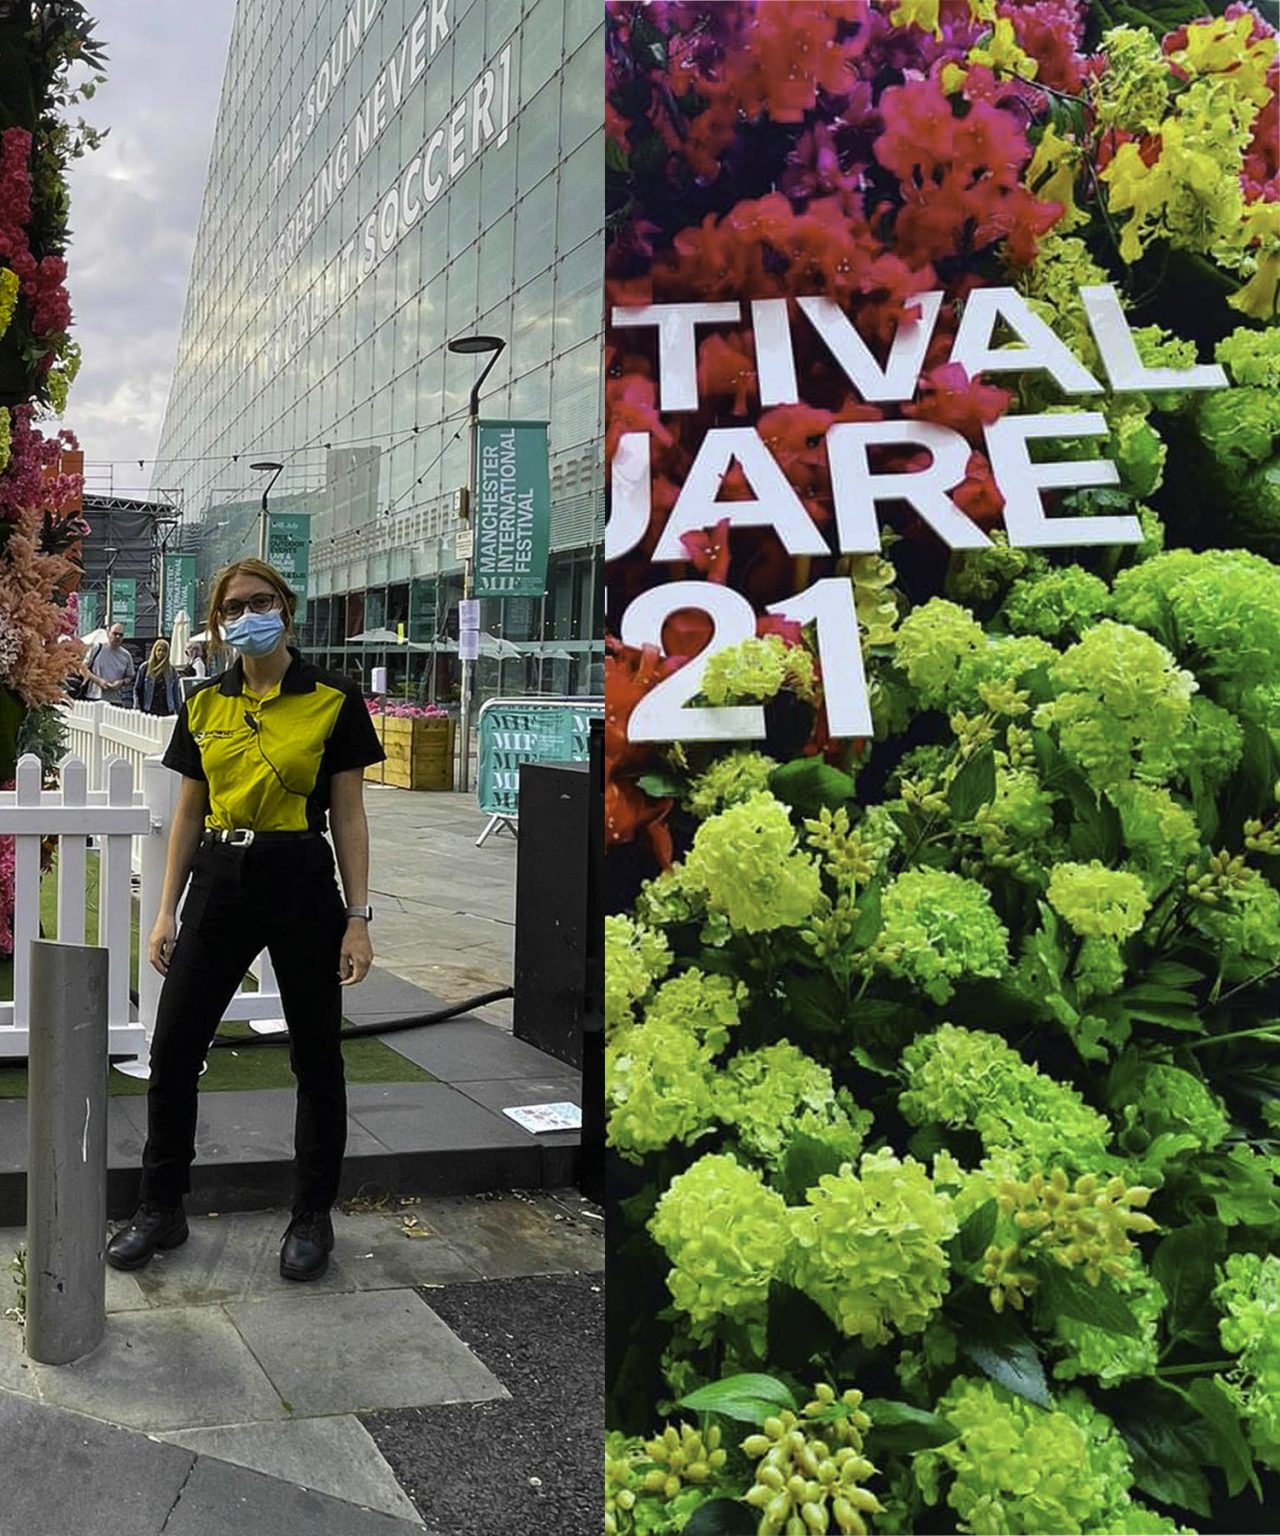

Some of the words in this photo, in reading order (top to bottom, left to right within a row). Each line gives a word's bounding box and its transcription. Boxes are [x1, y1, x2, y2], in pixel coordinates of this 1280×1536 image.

[354, 0, 450, 166] NEVER
[611, 285, 1229, 412] TIVAL
[479, 445, 499, 573] MANCHESTER
[497, 427, 516, 573] INTERNATIONAL
[515, 487, 534, 573] FESTIVAL
[620, 577, 874, 744] 21
[491, 732, 538, 750] MIF
